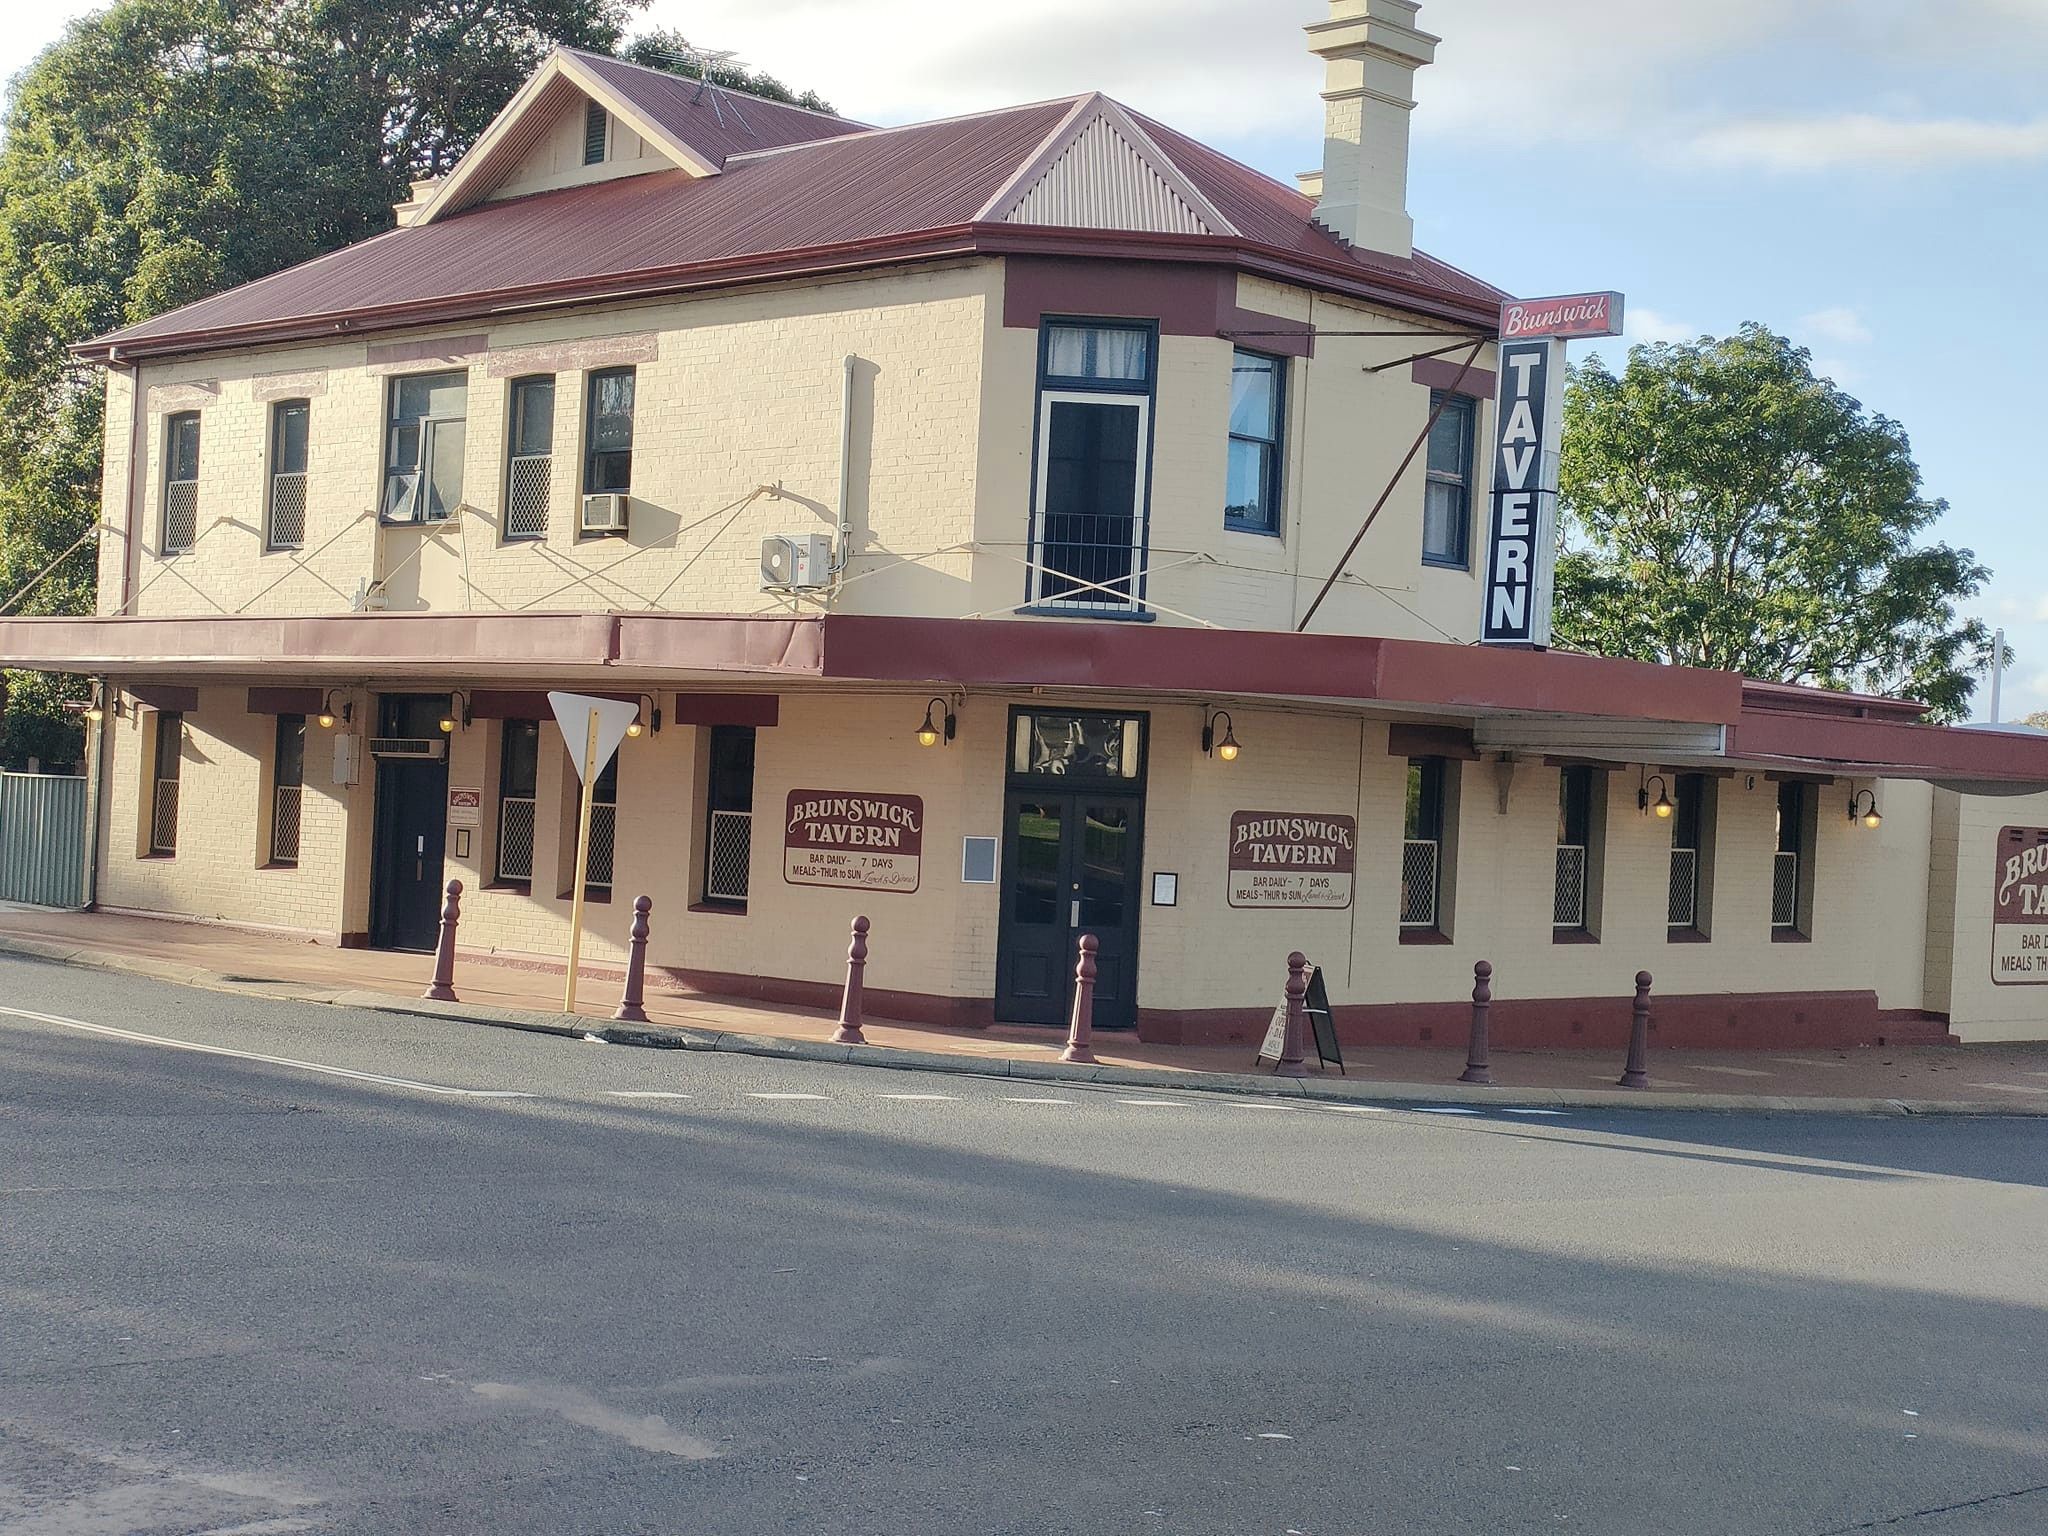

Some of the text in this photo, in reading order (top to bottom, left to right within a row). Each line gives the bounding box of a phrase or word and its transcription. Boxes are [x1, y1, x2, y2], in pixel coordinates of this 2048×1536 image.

[1505, 296, 1607, 335] Brunswick
[1491, 352, 1541, 630] TAVERN
[788, 798, 921, 834] BRUNSWICK
[804, 822, 901, 847] TAVERN
[1233, 818, 1353, 854] BRUNSWICK
[809, 853, 825, 864] BAR
[861, 857, 867, 867] 7
[872, 858, 893, 869] DAYS
[1249, 843, 1337, 865] TAVERN
[839, 870, 847, 879] to
[847, 870, 861, 880] SUN
[1253, 877, 1268, 887] BAR
[1299, 878, 1304, 888] 7
[1310, 878, 1330, 888] DAYS
[1281, 891, 1288, 900] to
[1288, 890, 1302, 900] SUN
[2022, 934, 2041, 949] BAR
[2001, 956, 2032, 971] MEALS
